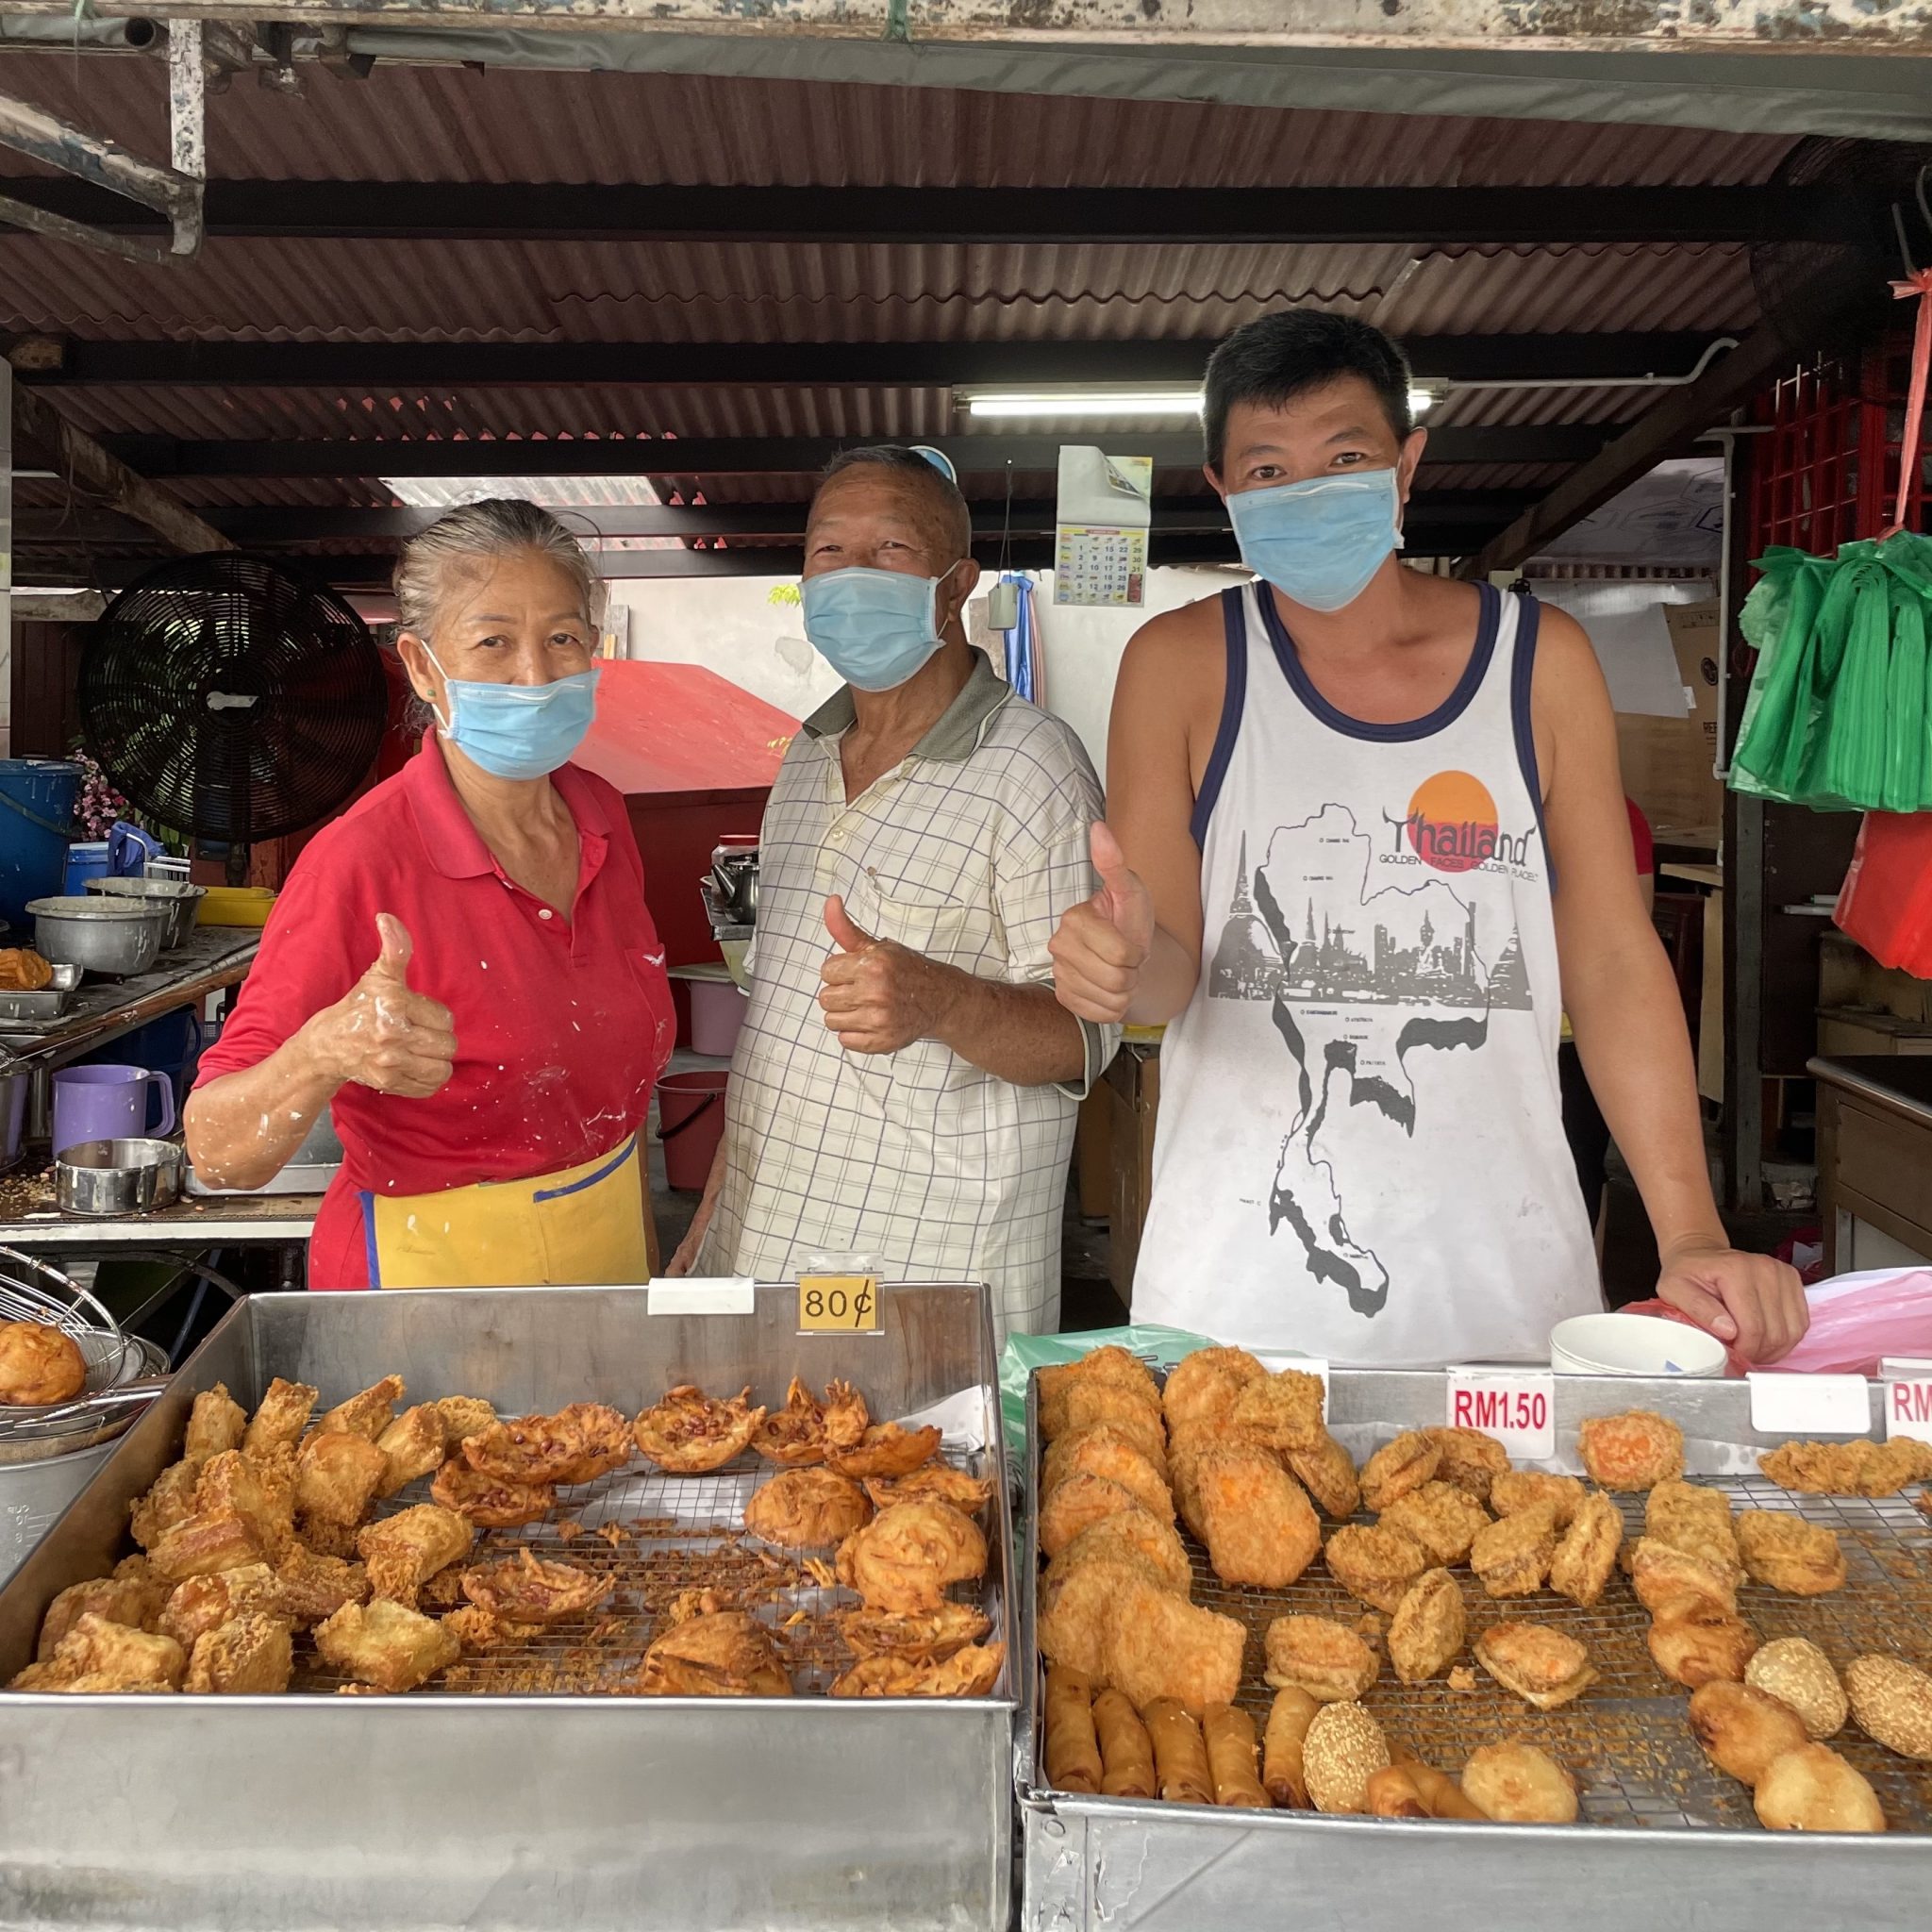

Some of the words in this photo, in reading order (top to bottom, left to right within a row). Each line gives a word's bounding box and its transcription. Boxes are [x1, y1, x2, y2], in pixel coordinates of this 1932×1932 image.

[1382, 806, 1537, 866] Thailand
[1379, 854, 1422, 865] GOLDEN
[1430, 857, 1465, 868] FACES
[1471, 861, 1508, 874] GOLDEN
[805, 1279, 872, 1328] 80¢
[1455, 1390, 1546, 1430] RM1.50
